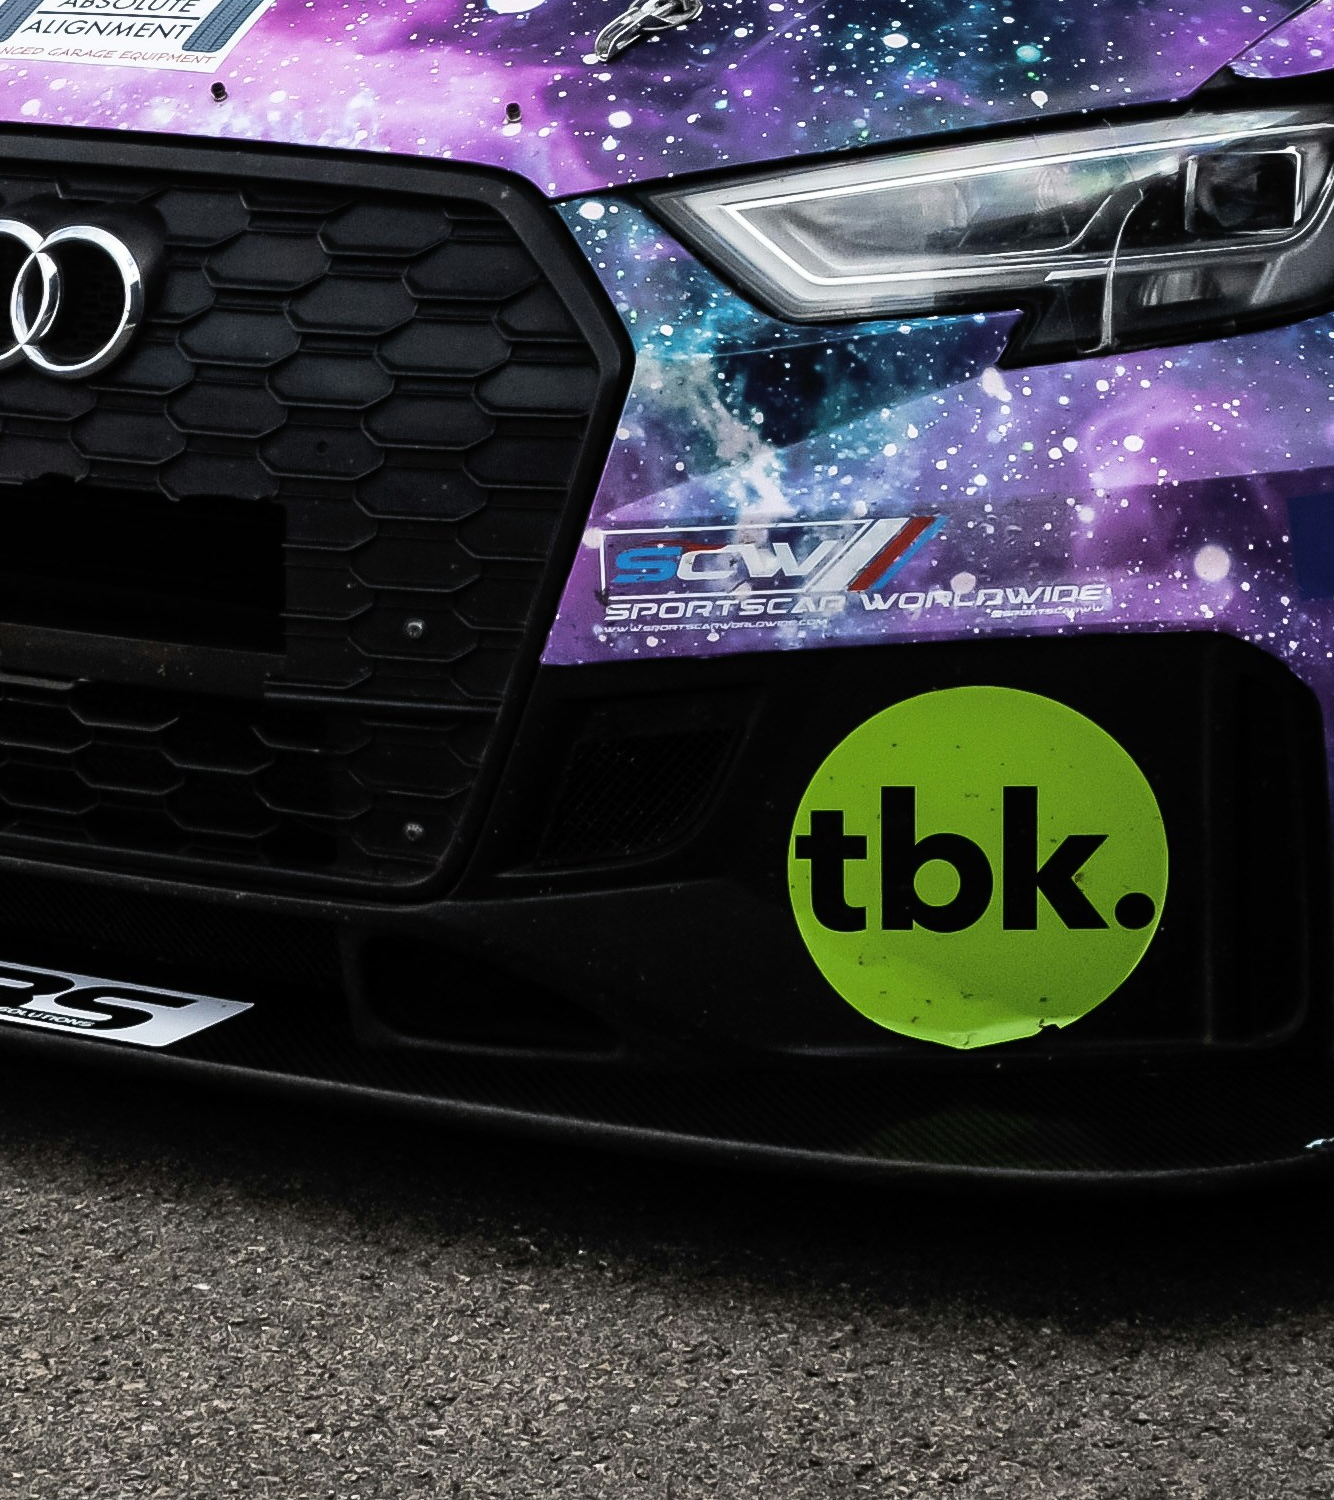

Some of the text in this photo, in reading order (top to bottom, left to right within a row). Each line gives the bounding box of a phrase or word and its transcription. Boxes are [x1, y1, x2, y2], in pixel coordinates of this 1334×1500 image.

[20, 19, 194, 41] ALIGNMENT
[47, 48, 114, 60] GARAGE
[118, 51, 217, 65] EQUIPMENT
[609, 540, 840, 584] SCW
[604, 583, 1107, 622] SPORTSCAR WORLDWIDE
[795, 785, 1156, 934] tbk.
